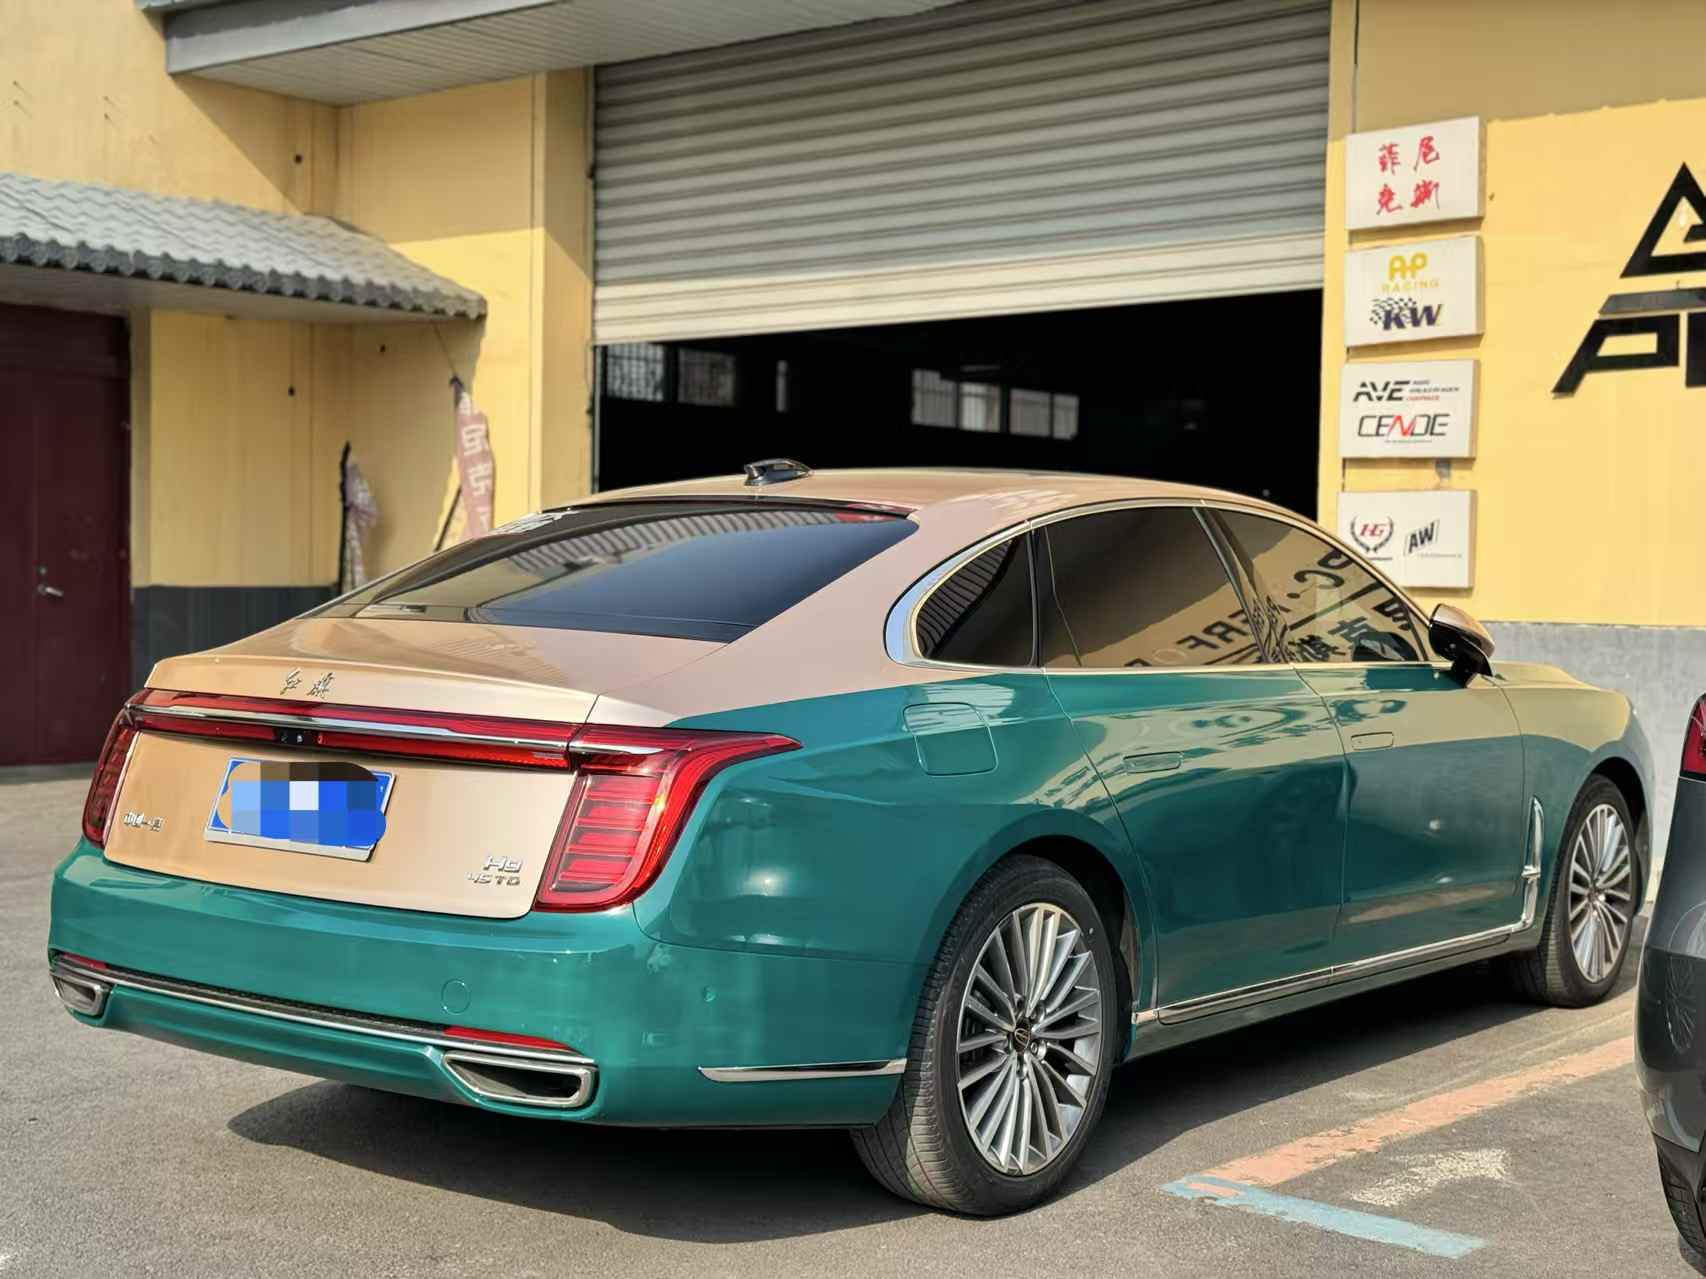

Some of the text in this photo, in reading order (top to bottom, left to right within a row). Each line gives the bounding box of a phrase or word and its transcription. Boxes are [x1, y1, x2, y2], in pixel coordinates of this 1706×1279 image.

[1388, 252, 1427, 280] AP
[1383, 303, 1443, 331] KW
[1353, 380, 1410, 402] AVE
[1408, 520, 1435, 554] AW
[483, 855, 523, 873] H9
